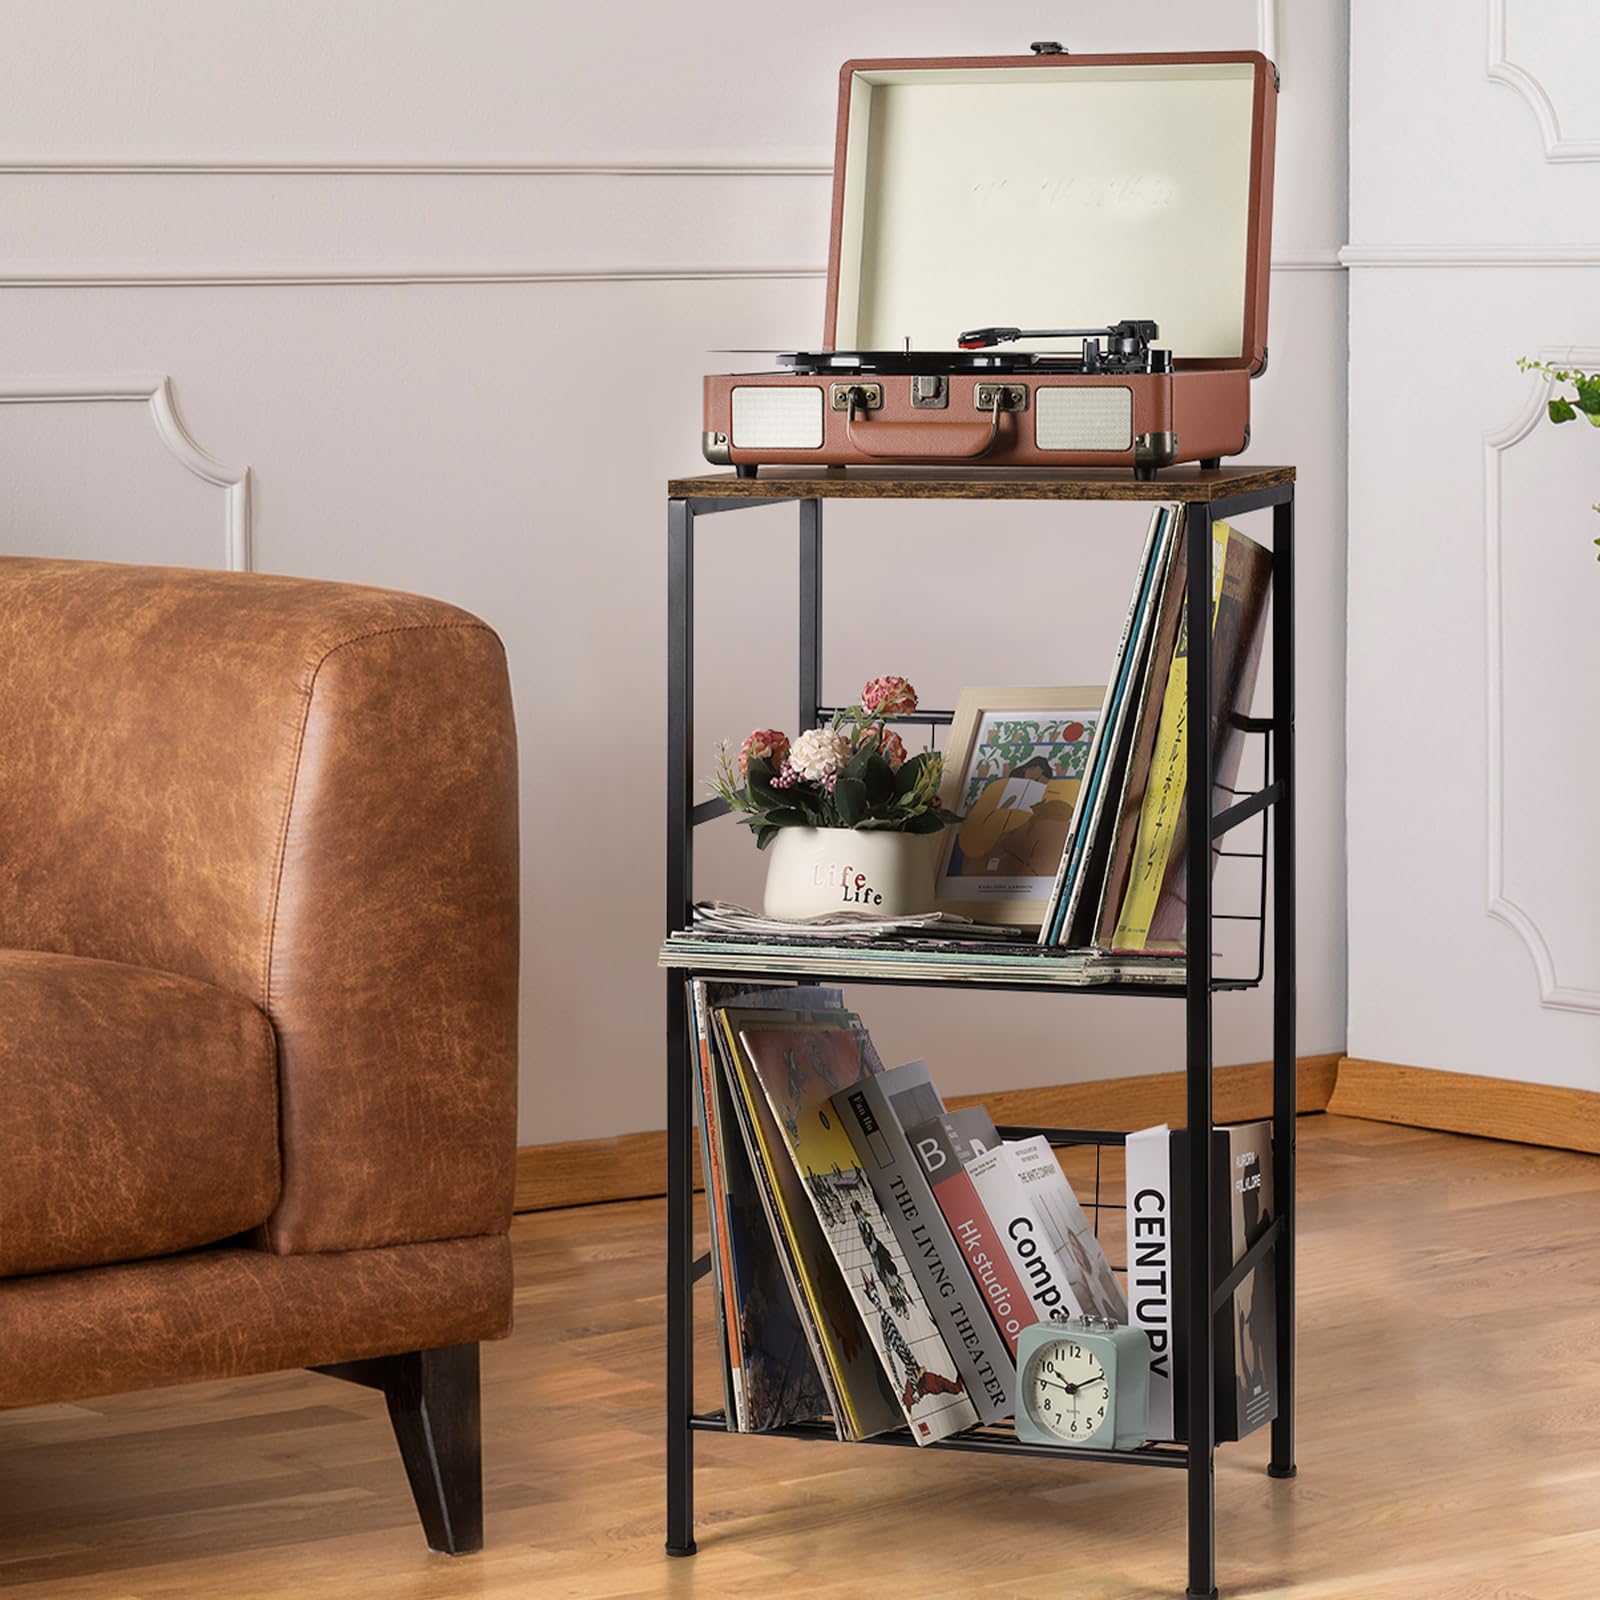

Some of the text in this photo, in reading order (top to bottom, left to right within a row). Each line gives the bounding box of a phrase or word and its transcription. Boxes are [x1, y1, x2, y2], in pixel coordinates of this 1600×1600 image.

[813, 864, 866, 888] Life
[842, 886, 882, 905] Life
[916, 1138, 947, 1173] B
[957, 1219, 981, 1252] Hk
[972, 1251, 1012, 1316] studio
[889, 1175, 1007, 1408] THE LIVING THEATER
[1055, 1349, 1065, 1361] 11
[1070, 1345, 1081, 1358] 12
[1089, 1353, 1093, 1365] 1
[1042, 1361, 1054, 1373] 10
[1099, 1368, 1105, 1381] 2
[1040, 1380, 1047, 1391] 9
[1102, 1387, 1109, 1399] 3
[1044, 1398, 1051, 1411] 8
[1097, 1406, 1104, 1418] 4
[1055, 1413, 1062, 1424] 7
[1086, 1417, 1092, 1429] 5
[1070, 1420, 1077, 1432] 6
